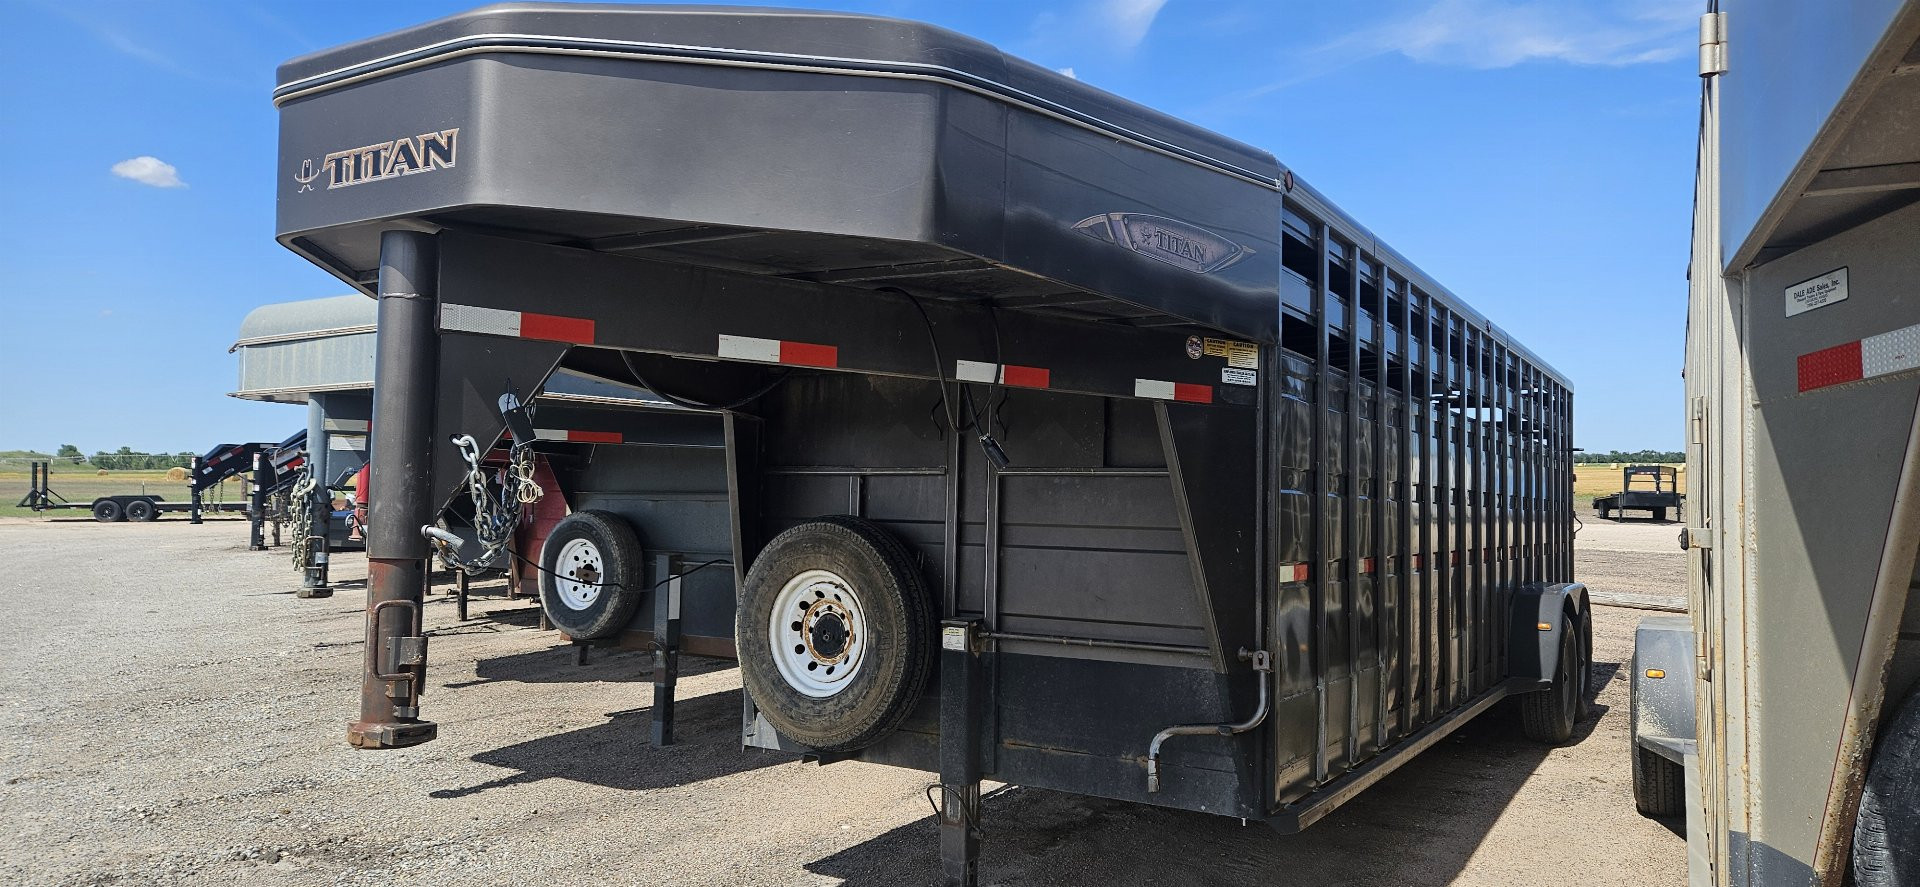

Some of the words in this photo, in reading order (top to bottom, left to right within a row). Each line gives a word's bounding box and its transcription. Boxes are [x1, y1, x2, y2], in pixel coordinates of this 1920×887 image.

[322, 128, 459, 190] TITAN
[1154, 227, 1207, 264] TITAN
[1793, 289, 1805, 300] DALE
[1233, 341, 1254, 349] CAUTION
